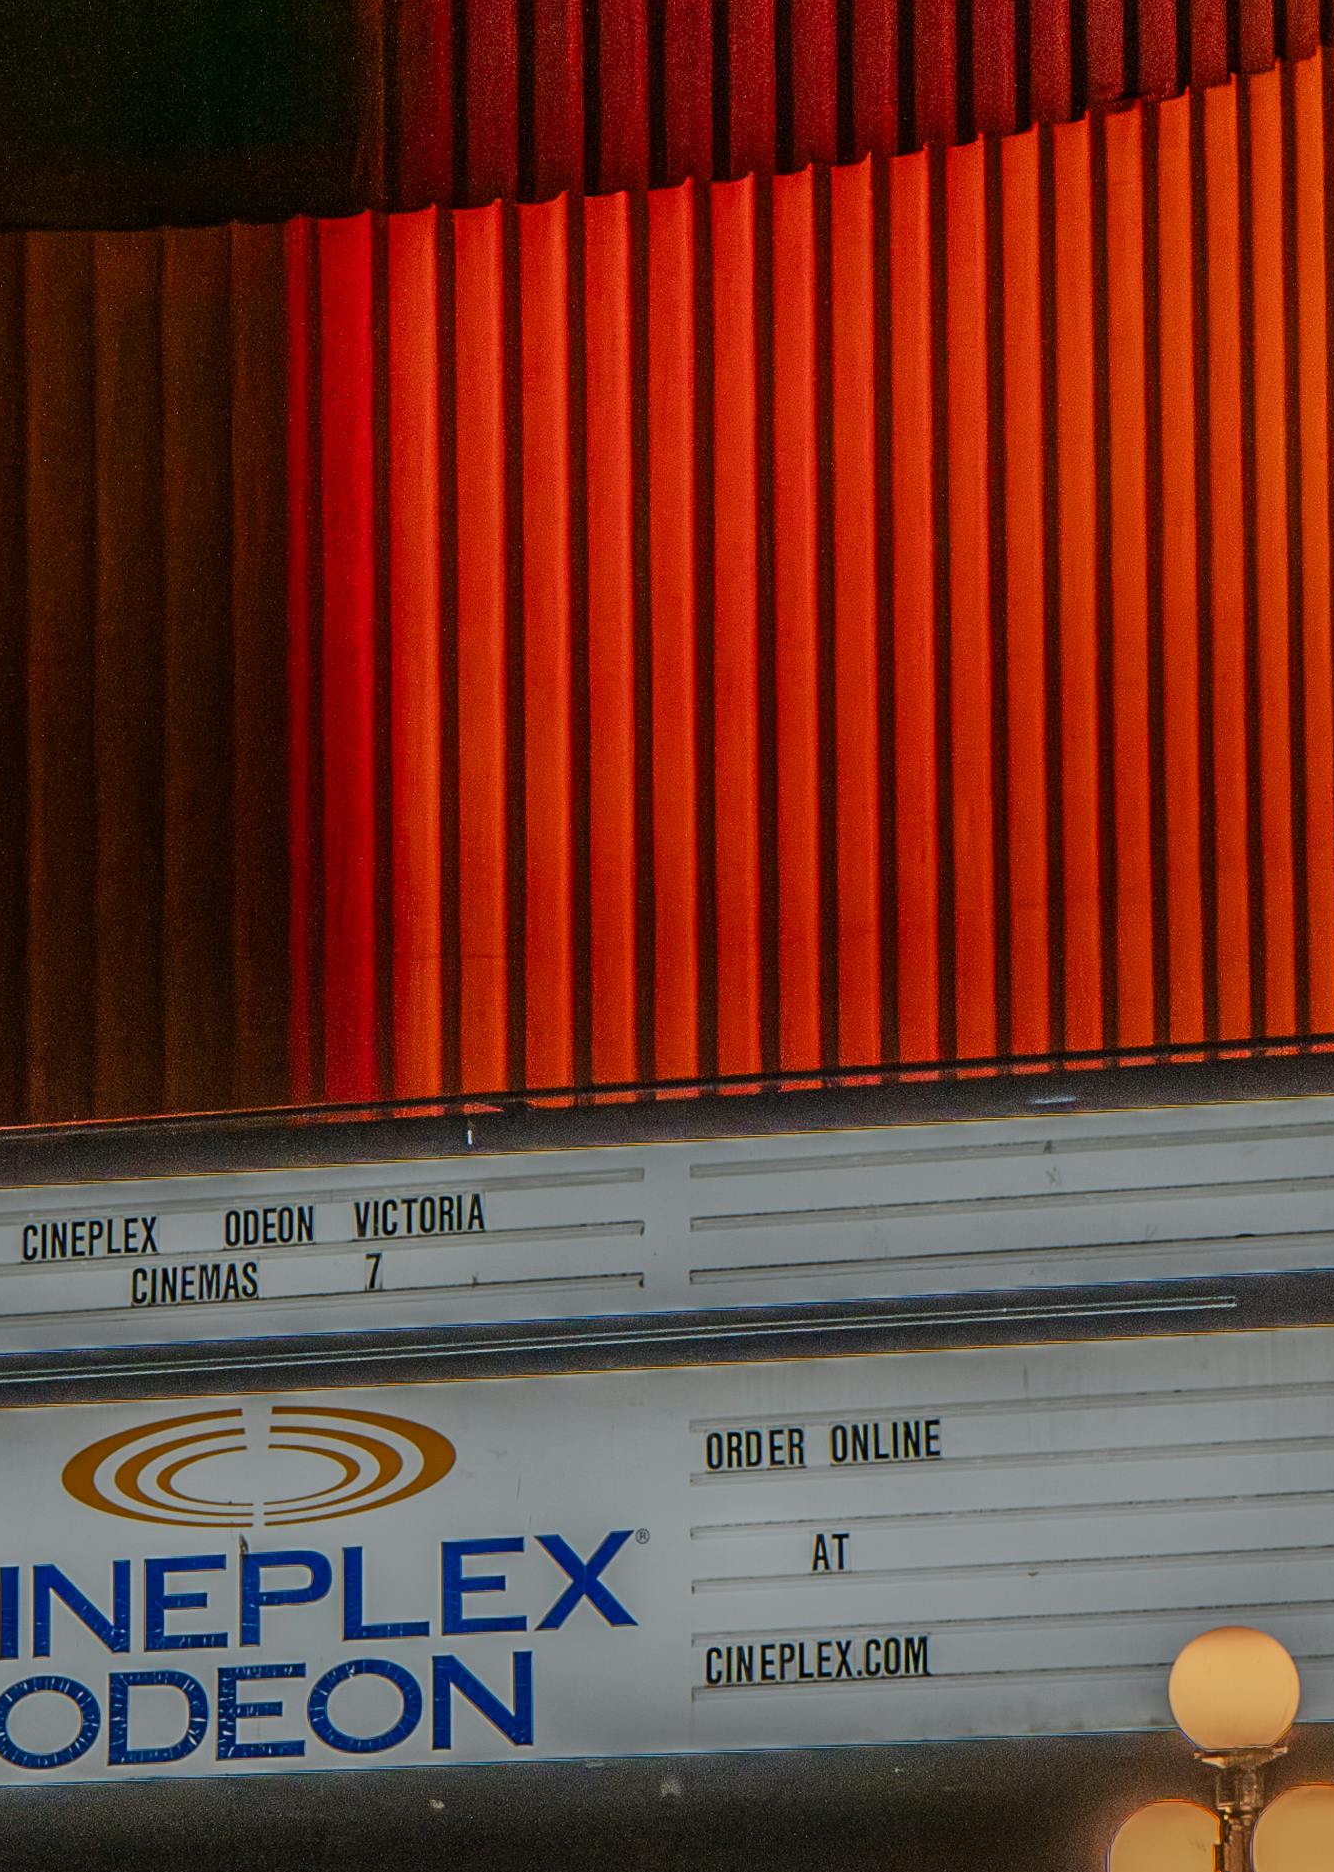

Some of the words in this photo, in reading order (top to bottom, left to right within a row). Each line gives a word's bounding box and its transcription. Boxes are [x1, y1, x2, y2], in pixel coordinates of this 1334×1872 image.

[22, 1217, 158, 1261] CINEPLEX
[225, 1205, 314, 1247] ODEON
[354, 1194, 484, 1237] VICTORIA
[132, 1263, 258, 1303] CINEMAS
[365, 1255, 382, 1290] 7
[705, 1427, 806, 1470] ORDER
[830, 1419, 941, 1462] ONLINE
[811, 1534, 849, 1572] AT
[705, 1637, 929, 1685] CINEPLEX.COM
